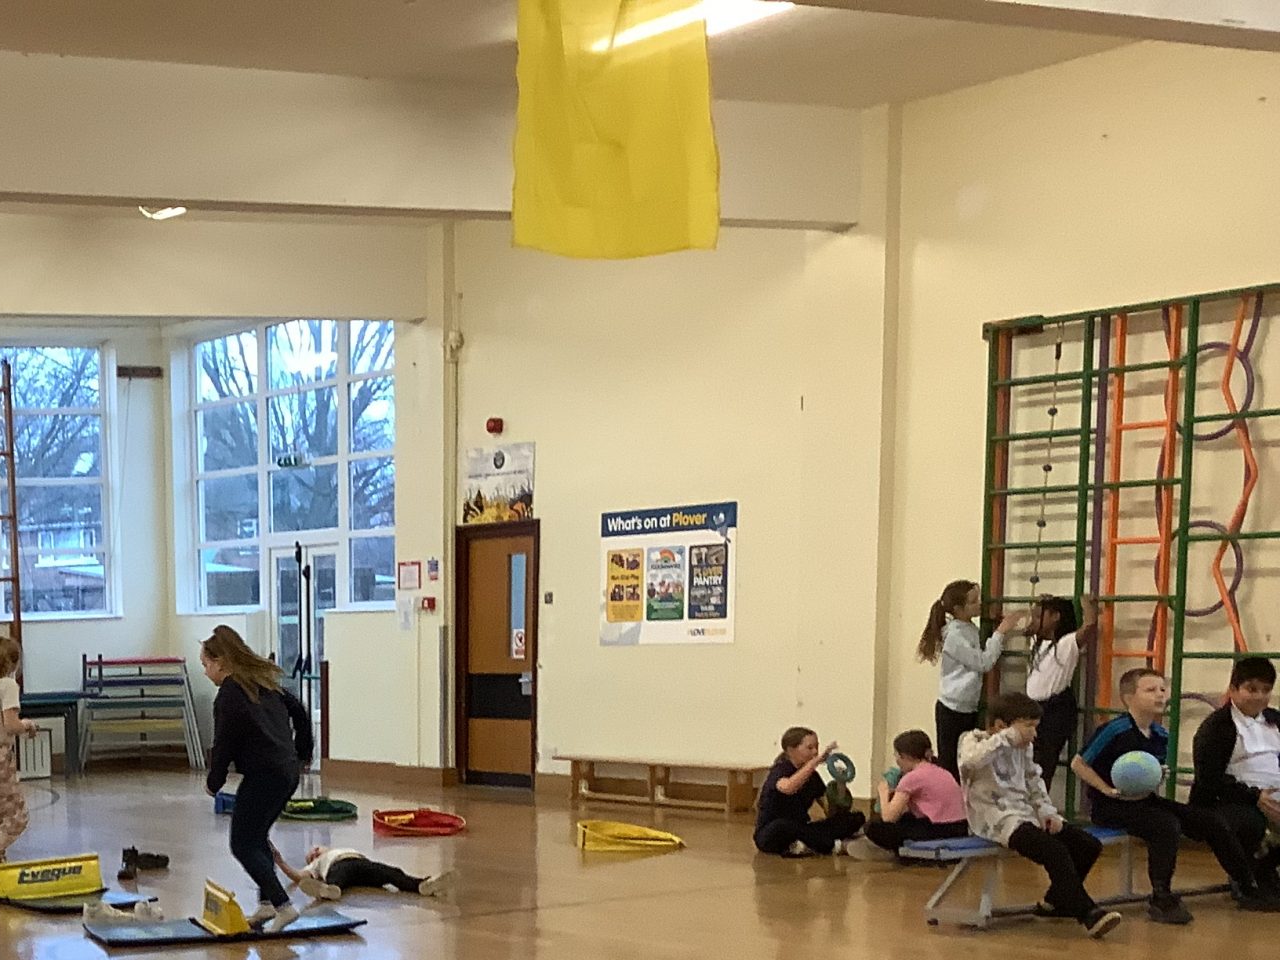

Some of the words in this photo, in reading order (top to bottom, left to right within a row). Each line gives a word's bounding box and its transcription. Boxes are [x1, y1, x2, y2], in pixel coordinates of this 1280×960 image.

[607, 515, 642, 532] What's
[643, 517, 658, 529] on
[659, 513, 671, 528] at
[672, 511, 707, 527] Plover
[693, 575, 723, 587] PANTRY
